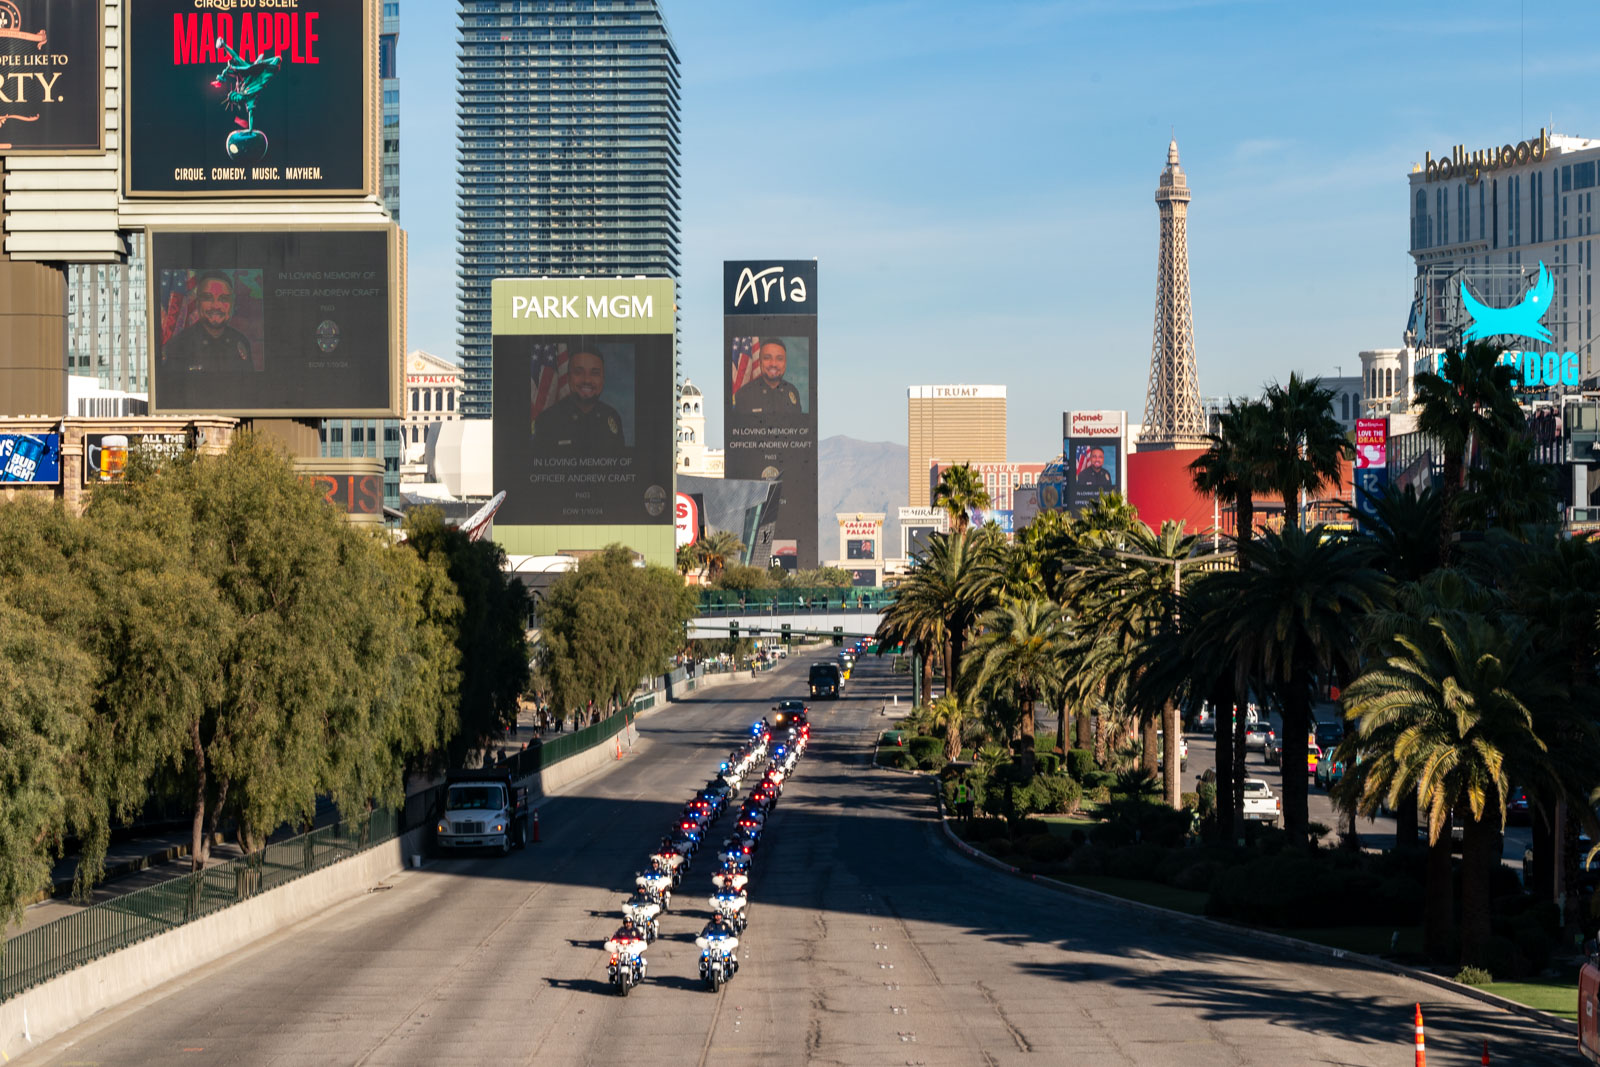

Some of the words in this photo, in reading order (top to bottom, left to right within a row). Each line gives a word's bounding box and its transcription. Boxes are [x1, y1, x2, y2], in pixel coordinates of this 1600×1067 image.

[194, 0, 237, 10] CIRQUE
[174, 13, 233, 65] MAD
[240, 12, 319, 64] APPLE
[0, 54, 21, 65] PLE
[24, 54, 49, 65] LIKE
[51, 54, 69, 65] TO
[1425, 127, 1546, 185] hollywood
[174, 167, 206, 181] CIRQUE.
[211, 167, 247, 181] COMEDY.
[252, 167, 281, 180] MUSIC.
[285, 167, 323, 180] MAYHEM.
[278, 271, 288, 280] IN
[290, 271, 321, 280] LOVING
[324, 271, 361, 280] MEMORY
[363, 271, 376, 280] OF
[734, 266, 807, 307] Aria
[275, 288, 311, 297] OFFICER
[313, 288, 351, 297] ANDREW
[352, 288, 380, 297] CRAFT
[512, 295, 579, 319] PARK
[586, 295, 654, 319] MGM
[936, 387, 979, 397] TRUMP
[1073, 412, 1103, 424] planet
[732, 428, 740, 436] IN
[741, 428, 766, 436] LOVING
[768, 428, 797, 436] MEMORY
[799, 428, 809, 436] OF
[1073, 425, 1119, 436] hollywood
[1358, 430, 1371, 438] LOVE
[1373, 430, 1384, 438] THE
[142, 434, 162, 443] ALL
[164, 434, 186, 443] THE
[729, 441, 757, 449] OFFICER
[758, 441, 789, 449] ANDREW
[790, 441, 812, 449] CRAFT
[11, 452, 37, 473] BUD
[533, 457, 543, 467] IN
[545, 457, 577, 467] LOVING
[580, 457, 618, 467] MEMORY
[620, 457, 633, 467] OF
[5, 460, 36, 482] LIGHT
[529, 473, 565, 483] OFFICER
[567, 473, 606, 483] ANDREW
[608, 473, 636, 483] CRAFT
